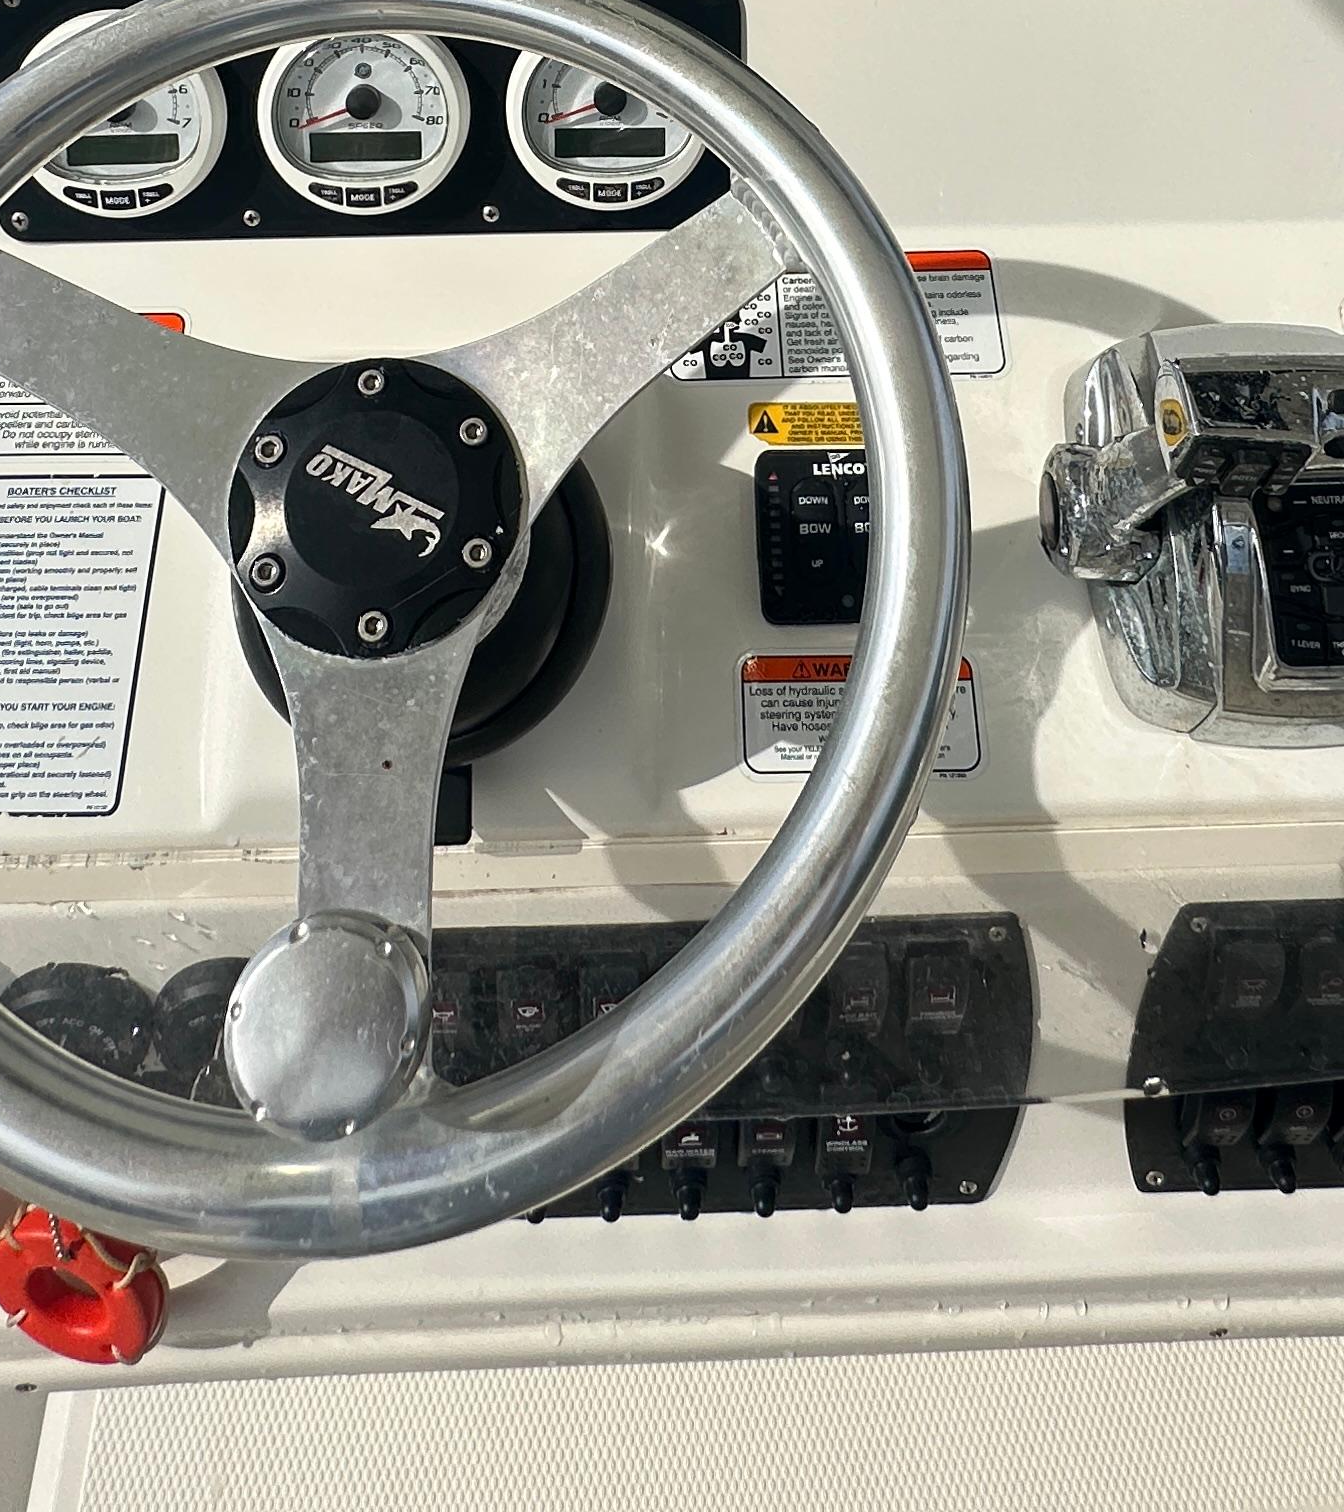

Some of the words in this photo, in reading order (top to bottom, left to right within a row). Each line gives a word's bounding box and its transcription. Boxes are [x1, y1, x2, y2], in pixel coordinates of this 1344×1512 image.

[179, 84, 188, 94] 6
[425, 86, 441, 95] 70
[182, 117, 192, 128] 7
[426, 116, 443, 125] 80
[350, 193, 375, 201] MODE
[598, 189, 622, 197] MODE
[105, 196, 131, 205] MODE
[944, 334, 974, 343] carbon
[729, 352, 743, 360] CO
[758, 358, 773, 366] CO
[788, 365, 818, 373] carbon
[34, 420, 53, 428] and
[2, 430, 16, 439] Do
[19, 431, 34, 439] not
[14, 440, 39, 449] while
[42, 441, 75, 450] engine
[812, 462, 865, 476] LENCO
[8, 487, 57, 497] BOATER'S
[59, 487, 117, 496] CHECKLIST
[798, 496, 828, 505] DOWN
[799, 522, 831, 534] BOW
[811, 559, 824, 568] UP
[749, 686, 773, 696] Loss
[776, 686, 786, 696] of
[789, 685, 836, 698] hydraulic
[0, 703, 18, 711] YOU
[20, 703, 49, 711] START
[51, 703, 77, 711] YOUR
[761, 699, 779, 708] can
[782, 699, 813, 708] cause
[760, 710, 801, 721] steering
[772, 722, 798, 732] Have
